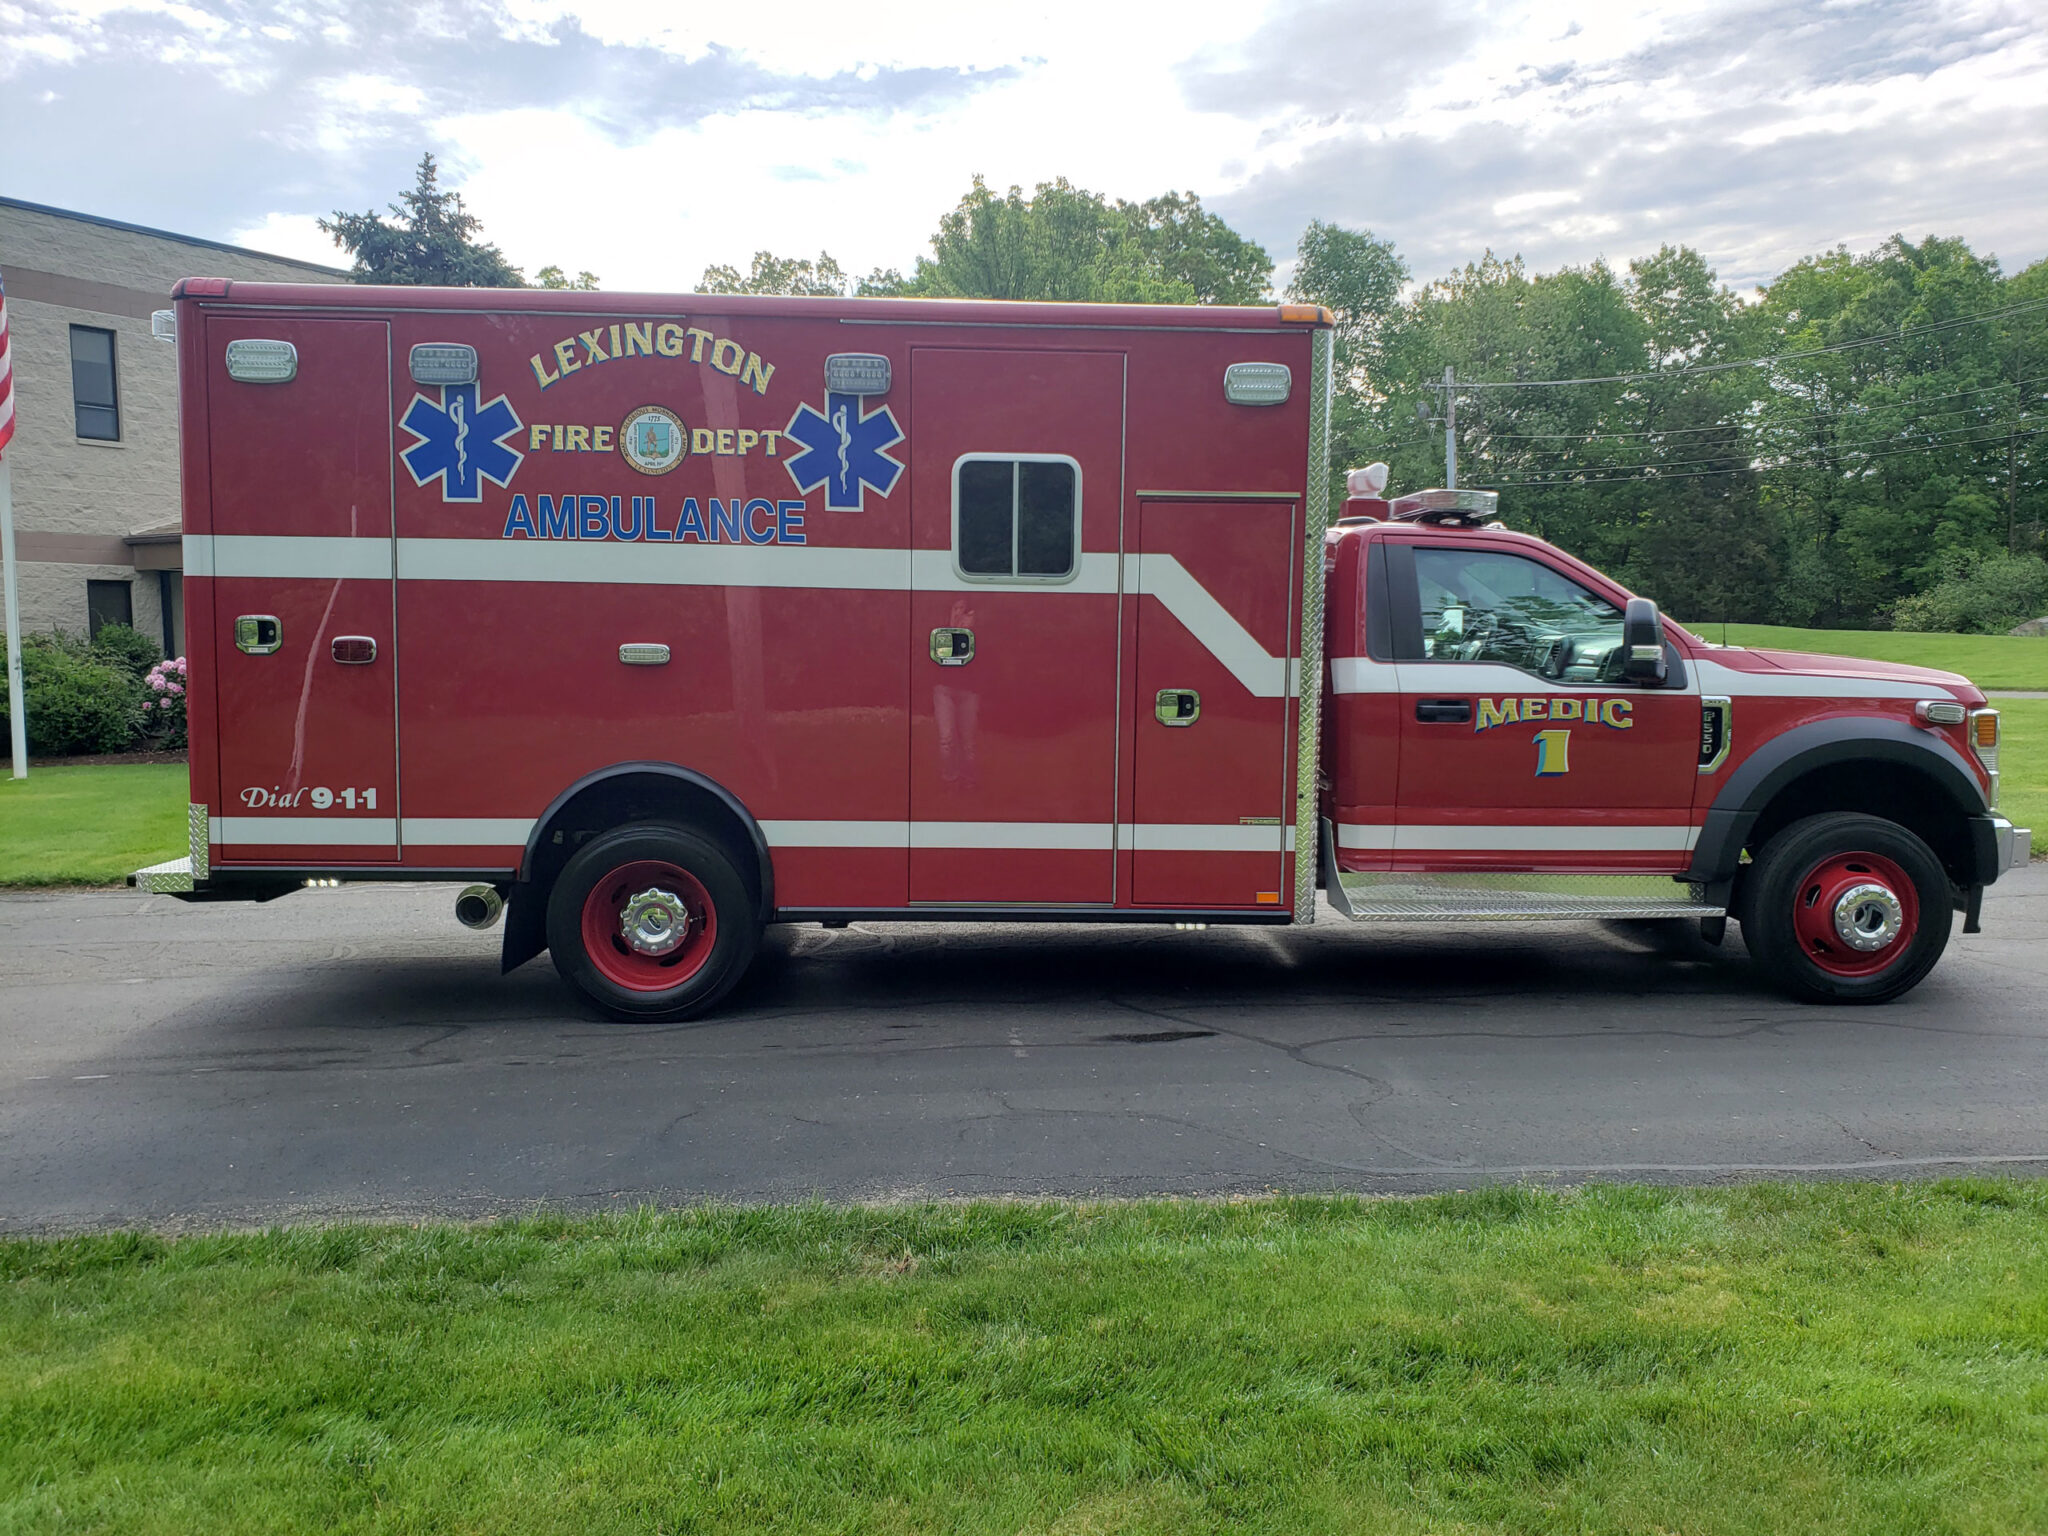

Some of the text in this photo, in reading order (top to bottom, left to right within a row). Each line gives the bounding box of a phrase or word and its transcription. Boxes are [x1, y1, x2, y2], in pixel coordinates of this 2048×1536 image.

[529, 322, 776, 396] LEXINGTON
[648, 415, 661, 423] 1775
[528, 424, 615, 453] FIRE
[691, 426, 783, 456] DEPT
[503, 494, 807, 545] AMBULANCE
[1475, 698, 1633, 733] MEDIC
[1532, 730, 1571, 777] 1
[240, 785, 377, 809] Dial 9-1-1
